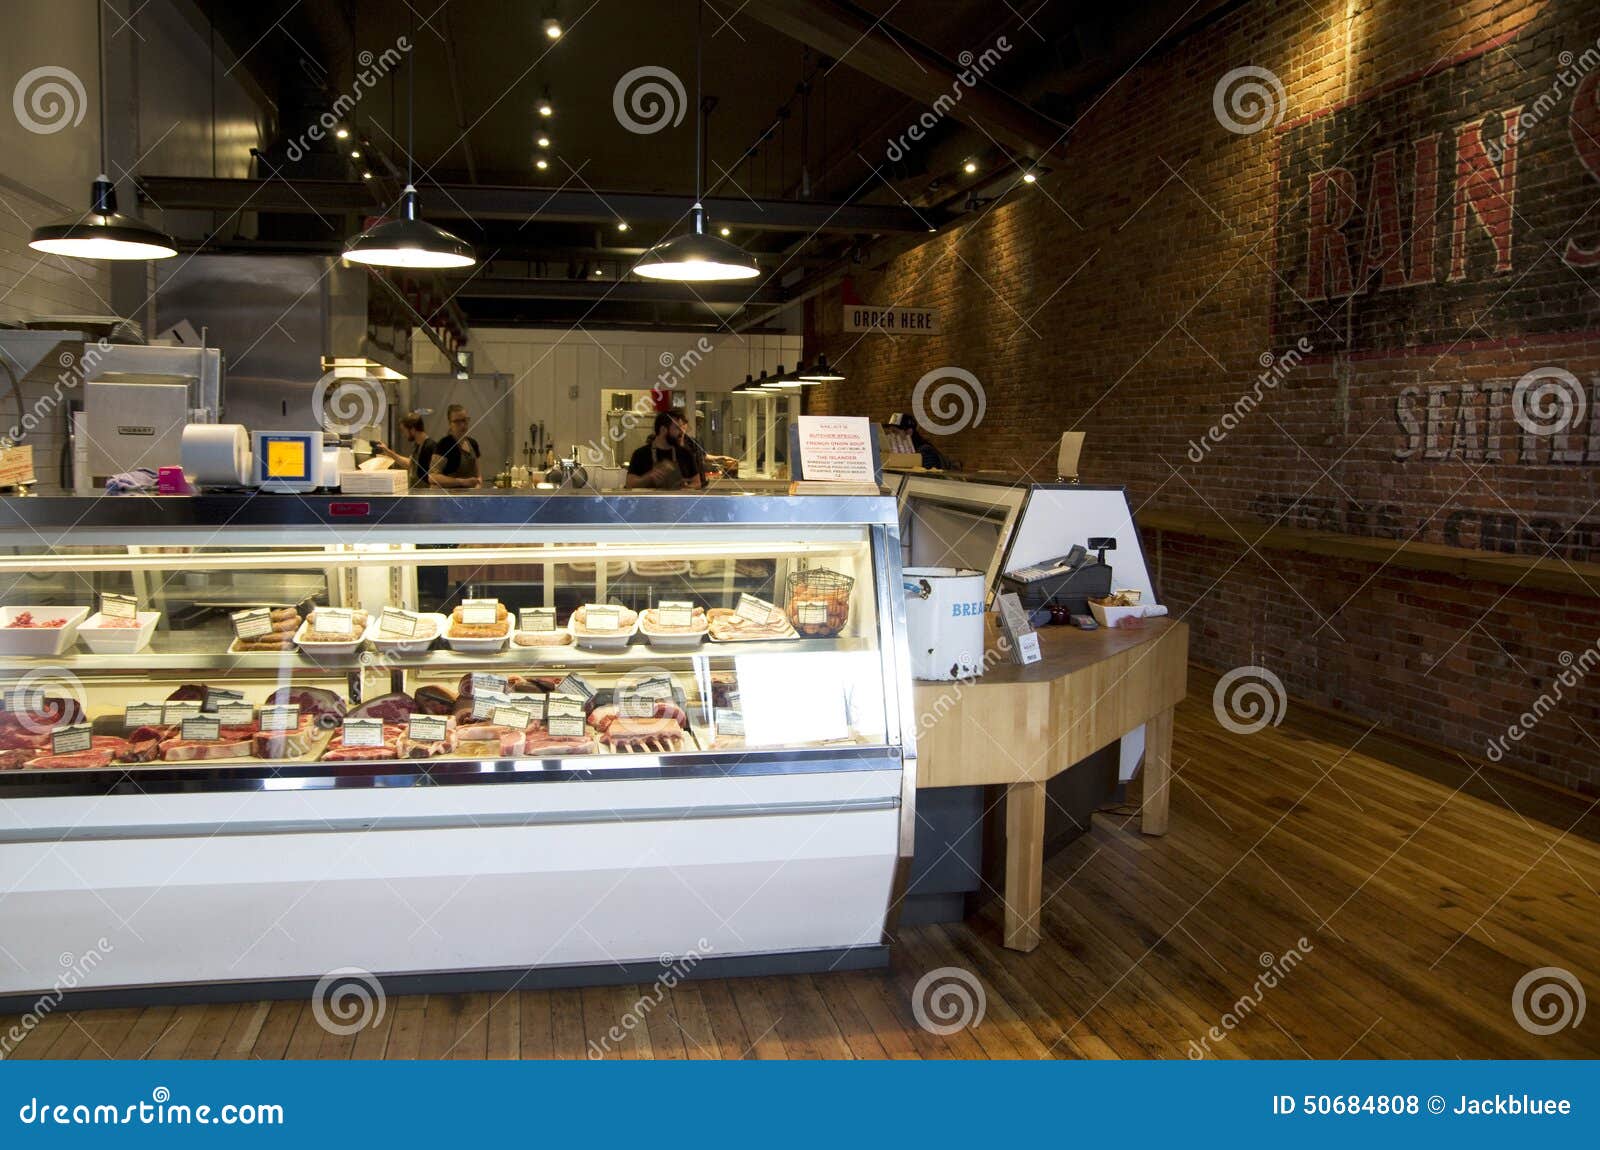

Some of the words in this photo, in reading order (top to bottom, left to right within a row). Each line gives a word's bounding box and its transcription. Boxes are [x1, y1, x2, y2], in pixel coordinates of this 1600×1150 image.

[1305, 105, 1525, 300] RAIN
[853, 310, 895, 328] ORDER
[901, 311, 932, 328] HERE
